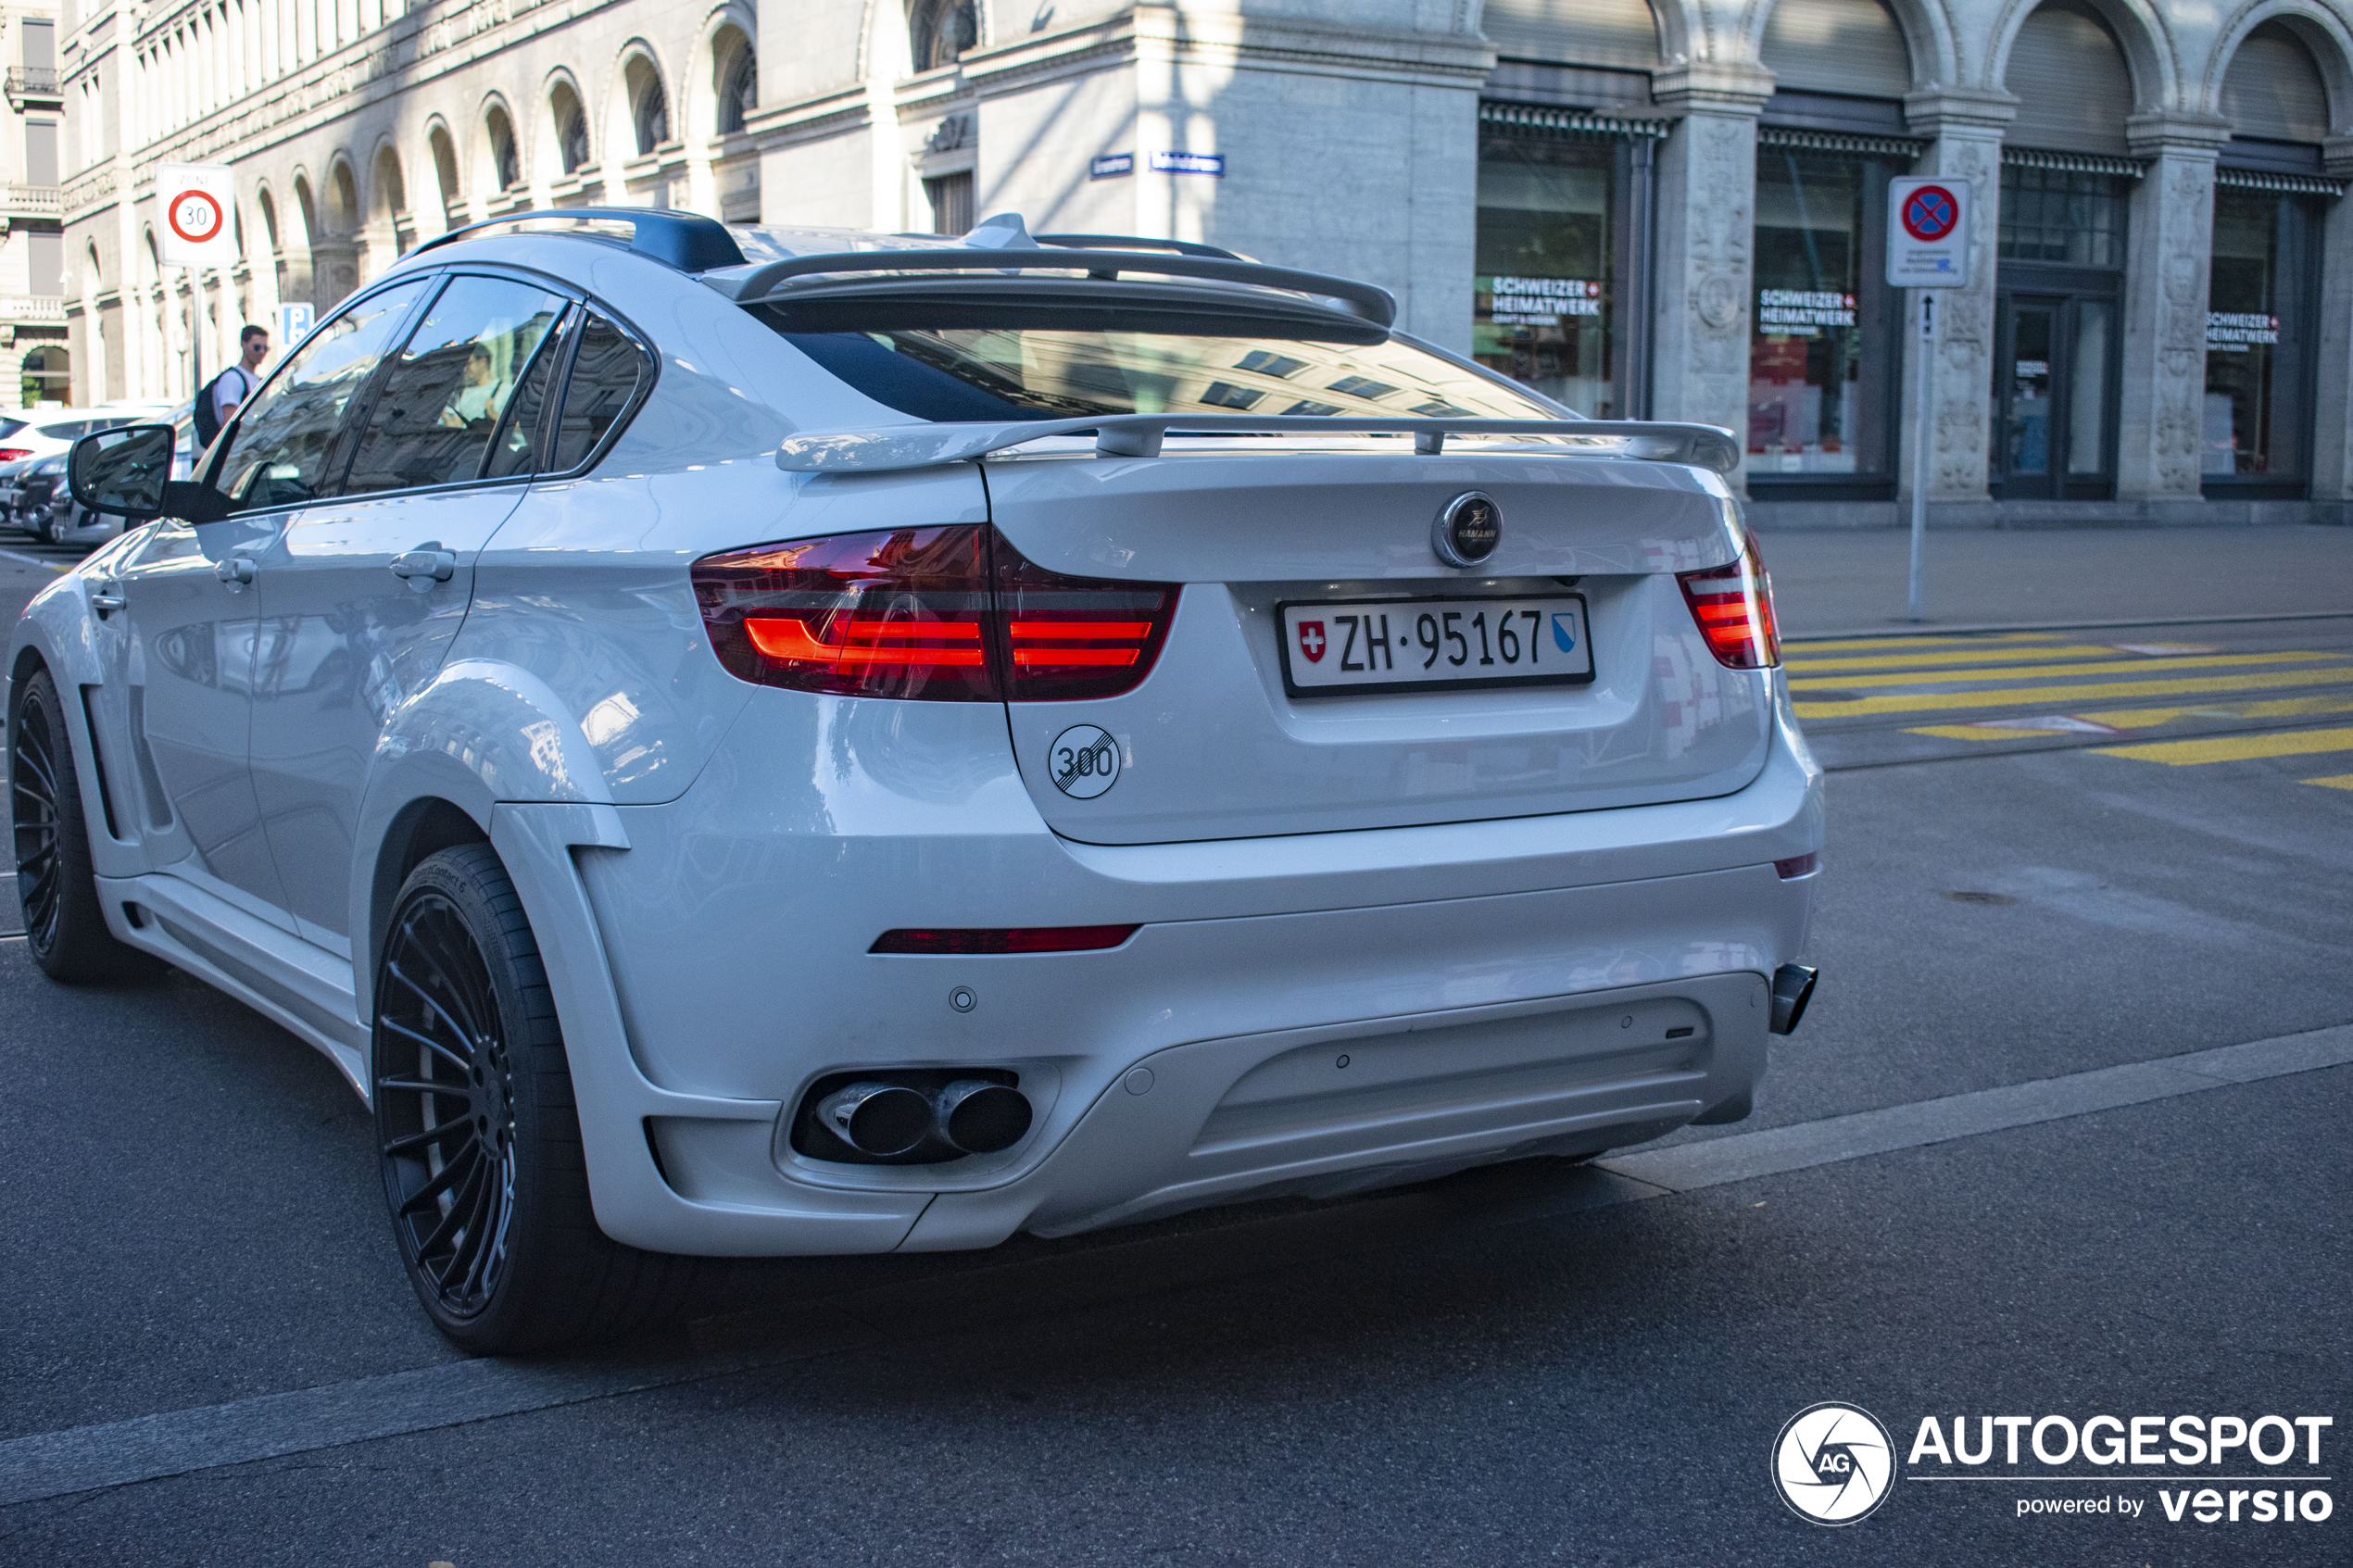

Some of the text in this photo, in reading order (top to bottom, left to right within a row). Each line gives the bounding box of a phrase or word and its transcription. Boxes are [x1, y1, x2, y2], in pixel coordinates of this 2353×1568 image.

[180, 175, 209, 185] ZONE
[185, 206, 207, 225] 30
[1492, 276, 1587, 297] SCHWEIZER
[1492, 295, 1599, 316] HEIMATWERK
[1760, 289, 1844, 309] SCHWEIZER
[290, 307, 305, 329] P
[1760, 307, 1856, 327] HEIMATWERK
[2205, 311, 2269, 329] SCHWEIZER
[2205, 326, 2279, 345] HEIMATWERK
[1458, 529, 1497, 538] HAMANN
[1057, 746, 1113, 777] 300
[459, 882, 466, 893] 6
